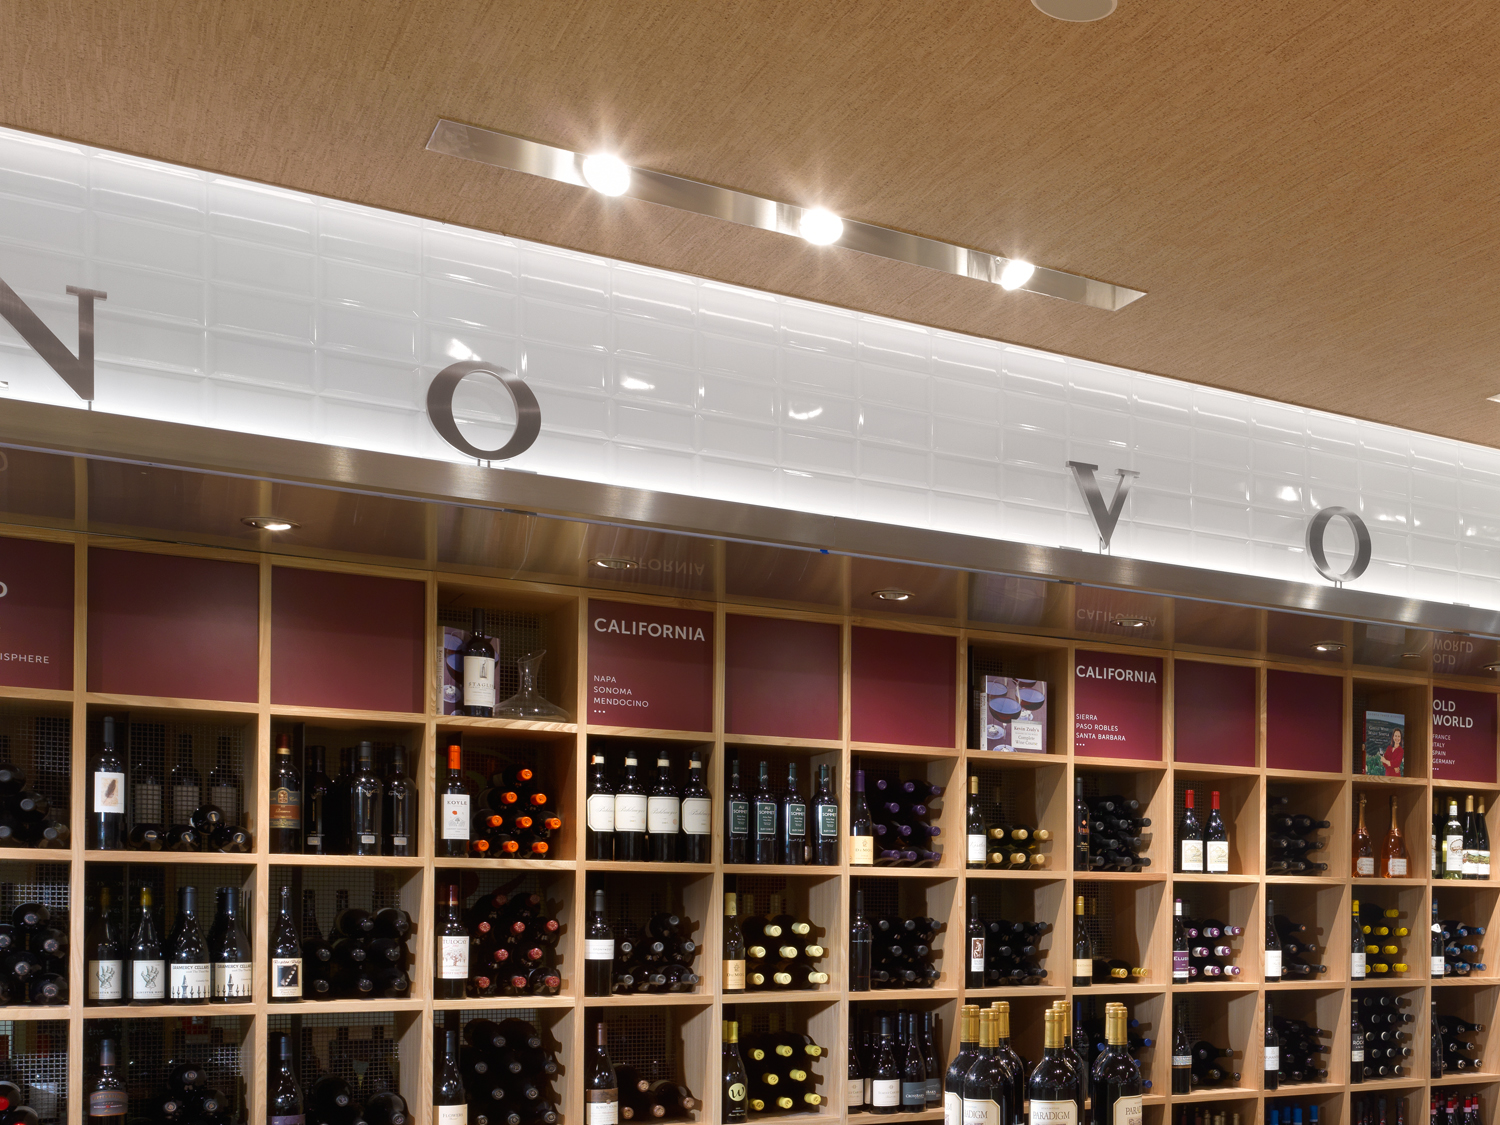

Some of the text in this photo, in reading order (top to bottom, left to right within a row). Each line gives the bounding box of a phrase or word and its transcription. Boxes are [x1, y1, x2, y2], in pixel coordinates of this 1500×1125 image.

[594, 618, 705, 642] CALIFORNIA
[594, 675, 617, 683] NAPA
[1076, 665, 1157, 684] CALIFORNIA
[594, 686, 632, 695] SONOMA
[594, 697, 649, 708] MENDOCINO
[1433, 699, 1456, 712] OLD
[1433, 714, 1473, 728] WORLD
[1095, 724, 1118, 732] ROBLES
[1032, 1111, 1070, 1120] PARADIGM
